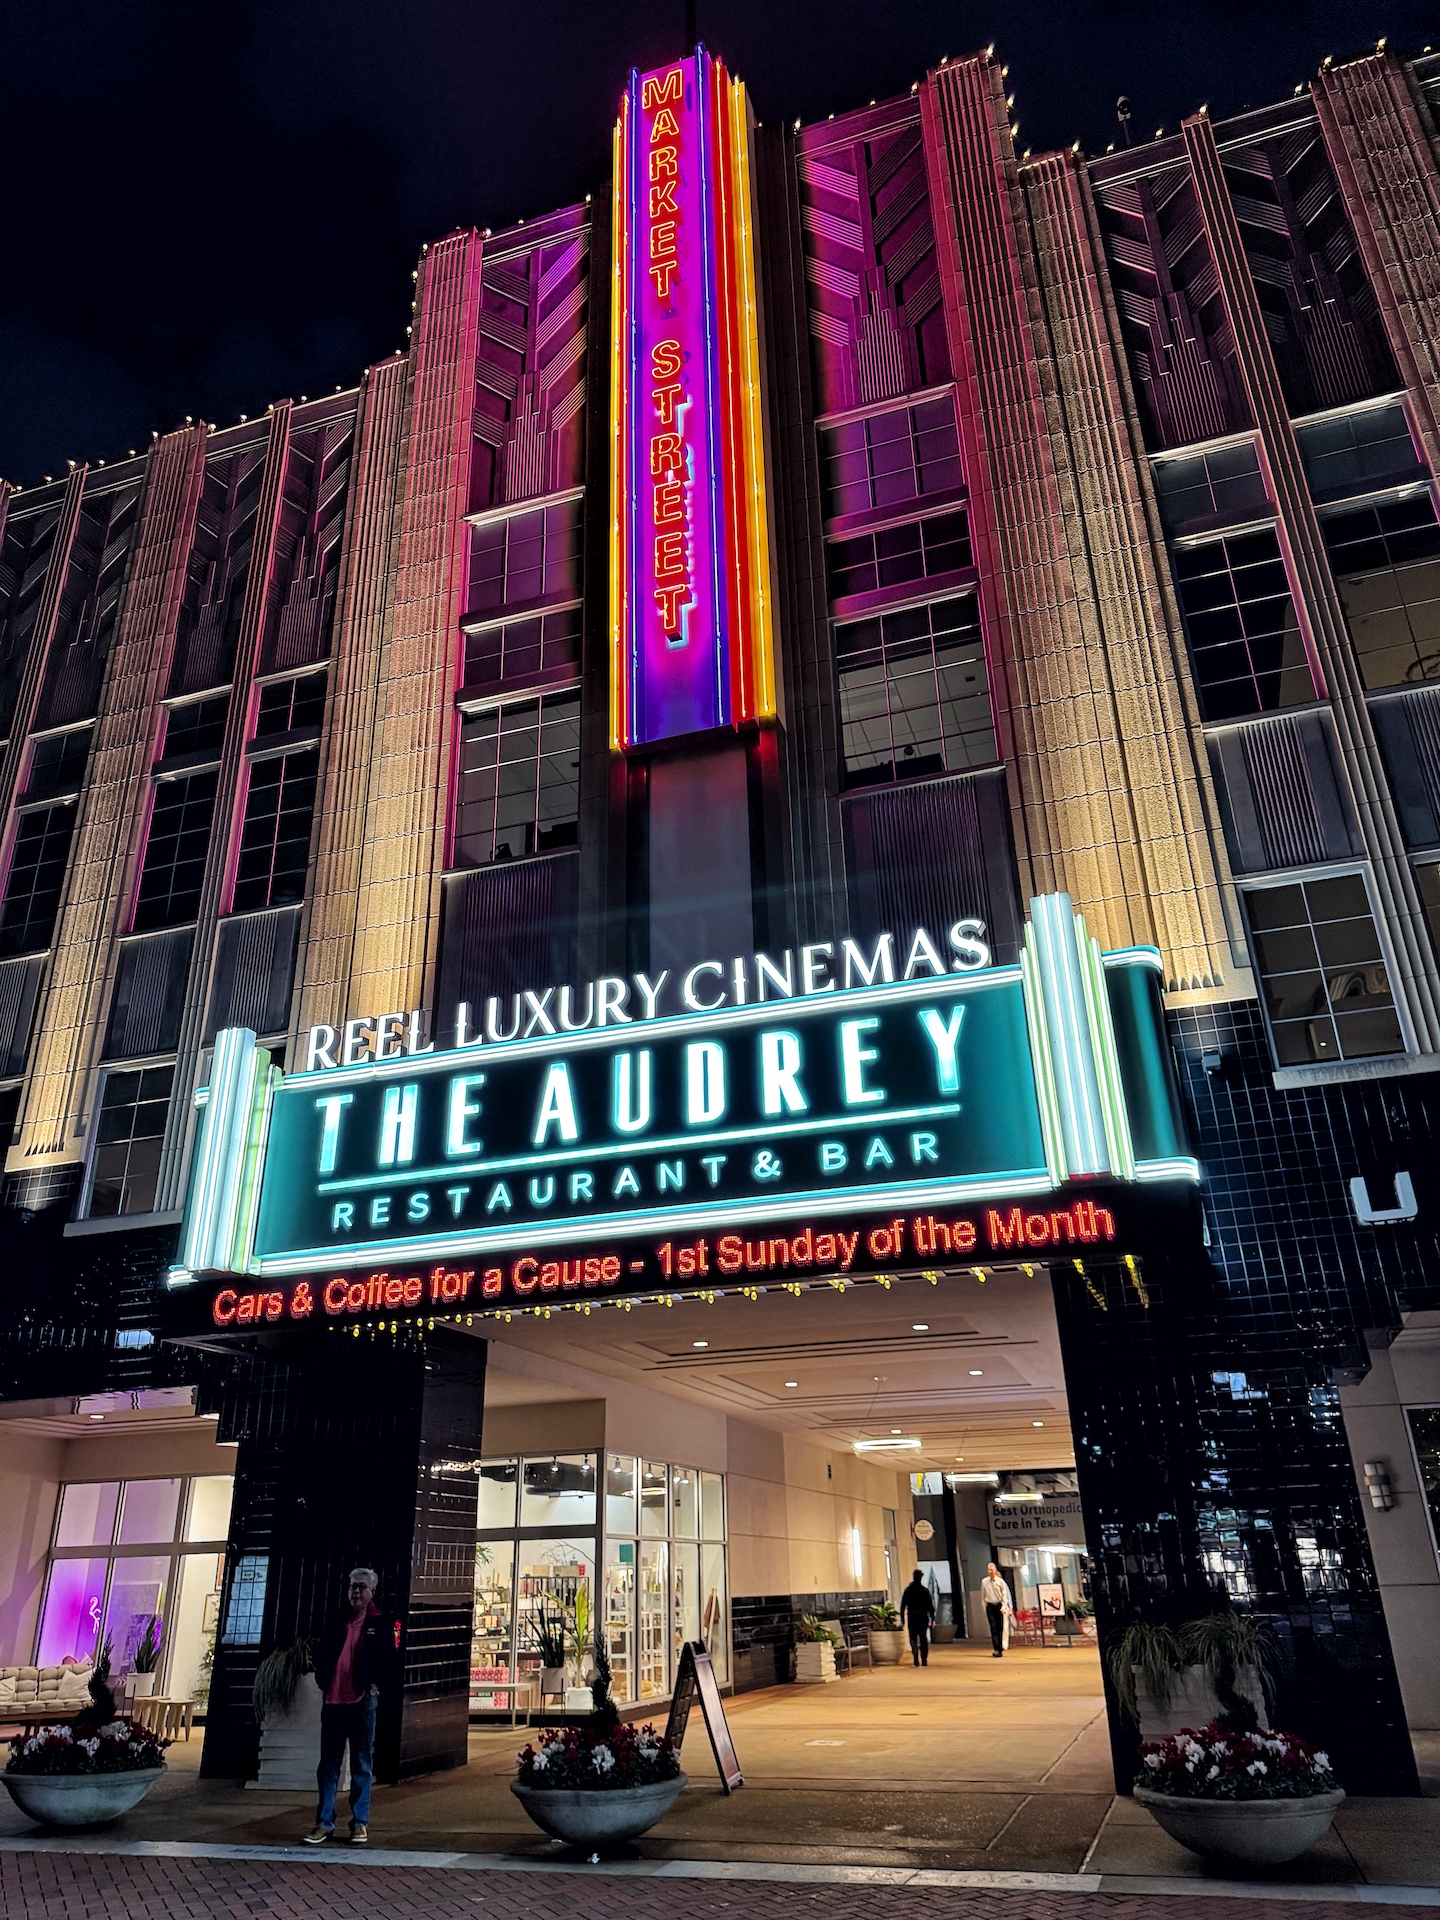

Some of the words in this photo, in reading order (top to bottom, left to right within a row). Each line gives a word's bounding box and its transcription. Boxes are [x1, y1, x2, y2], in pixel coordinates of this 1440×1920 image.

[642, 68, 682, 299] MARKET
[648, 338, 693, 636] STREET
[306, 1009, 434, 1073] REEL
[456, 969, 668, 1048] LUXURY
[684, 918, 992, 1011] CINEMAS
[315, 1074, 485, 1174] THE
[532, 1004, 966, 1145] AUDREY
[331, 1154, 727, 1230] RESTAURANT
[753, 1149, 782, 1180] &
[821, 1131, 940, 1172] BAR
[1349, 1171, 1418, 1226] U
[212, 1287, 284, 1326] Cars
[289, 1281, 314, 1315] &
[324, 1271, 424, 1312] Coffee
[430, 1266, 476, 1300] for
[482, 1266, 503, 1295] a
[512, 1253, 620, 1294] Cause
[657, 1238, 710, 1279] 1st
[717, 1227, 860, 1274] Sunday
[869, 1218, 906, 1258] of
[913, 1214, 977, 1252] the
[987, 1200, 1116, 1247] Month
[993, 1505, 1018, 1516] Best
[1020, 1502, 1083, 1517] Orthopedic
[994, 1518, 1019, 1530] Care
[1033, 1516, 1066, 1529] Texas
